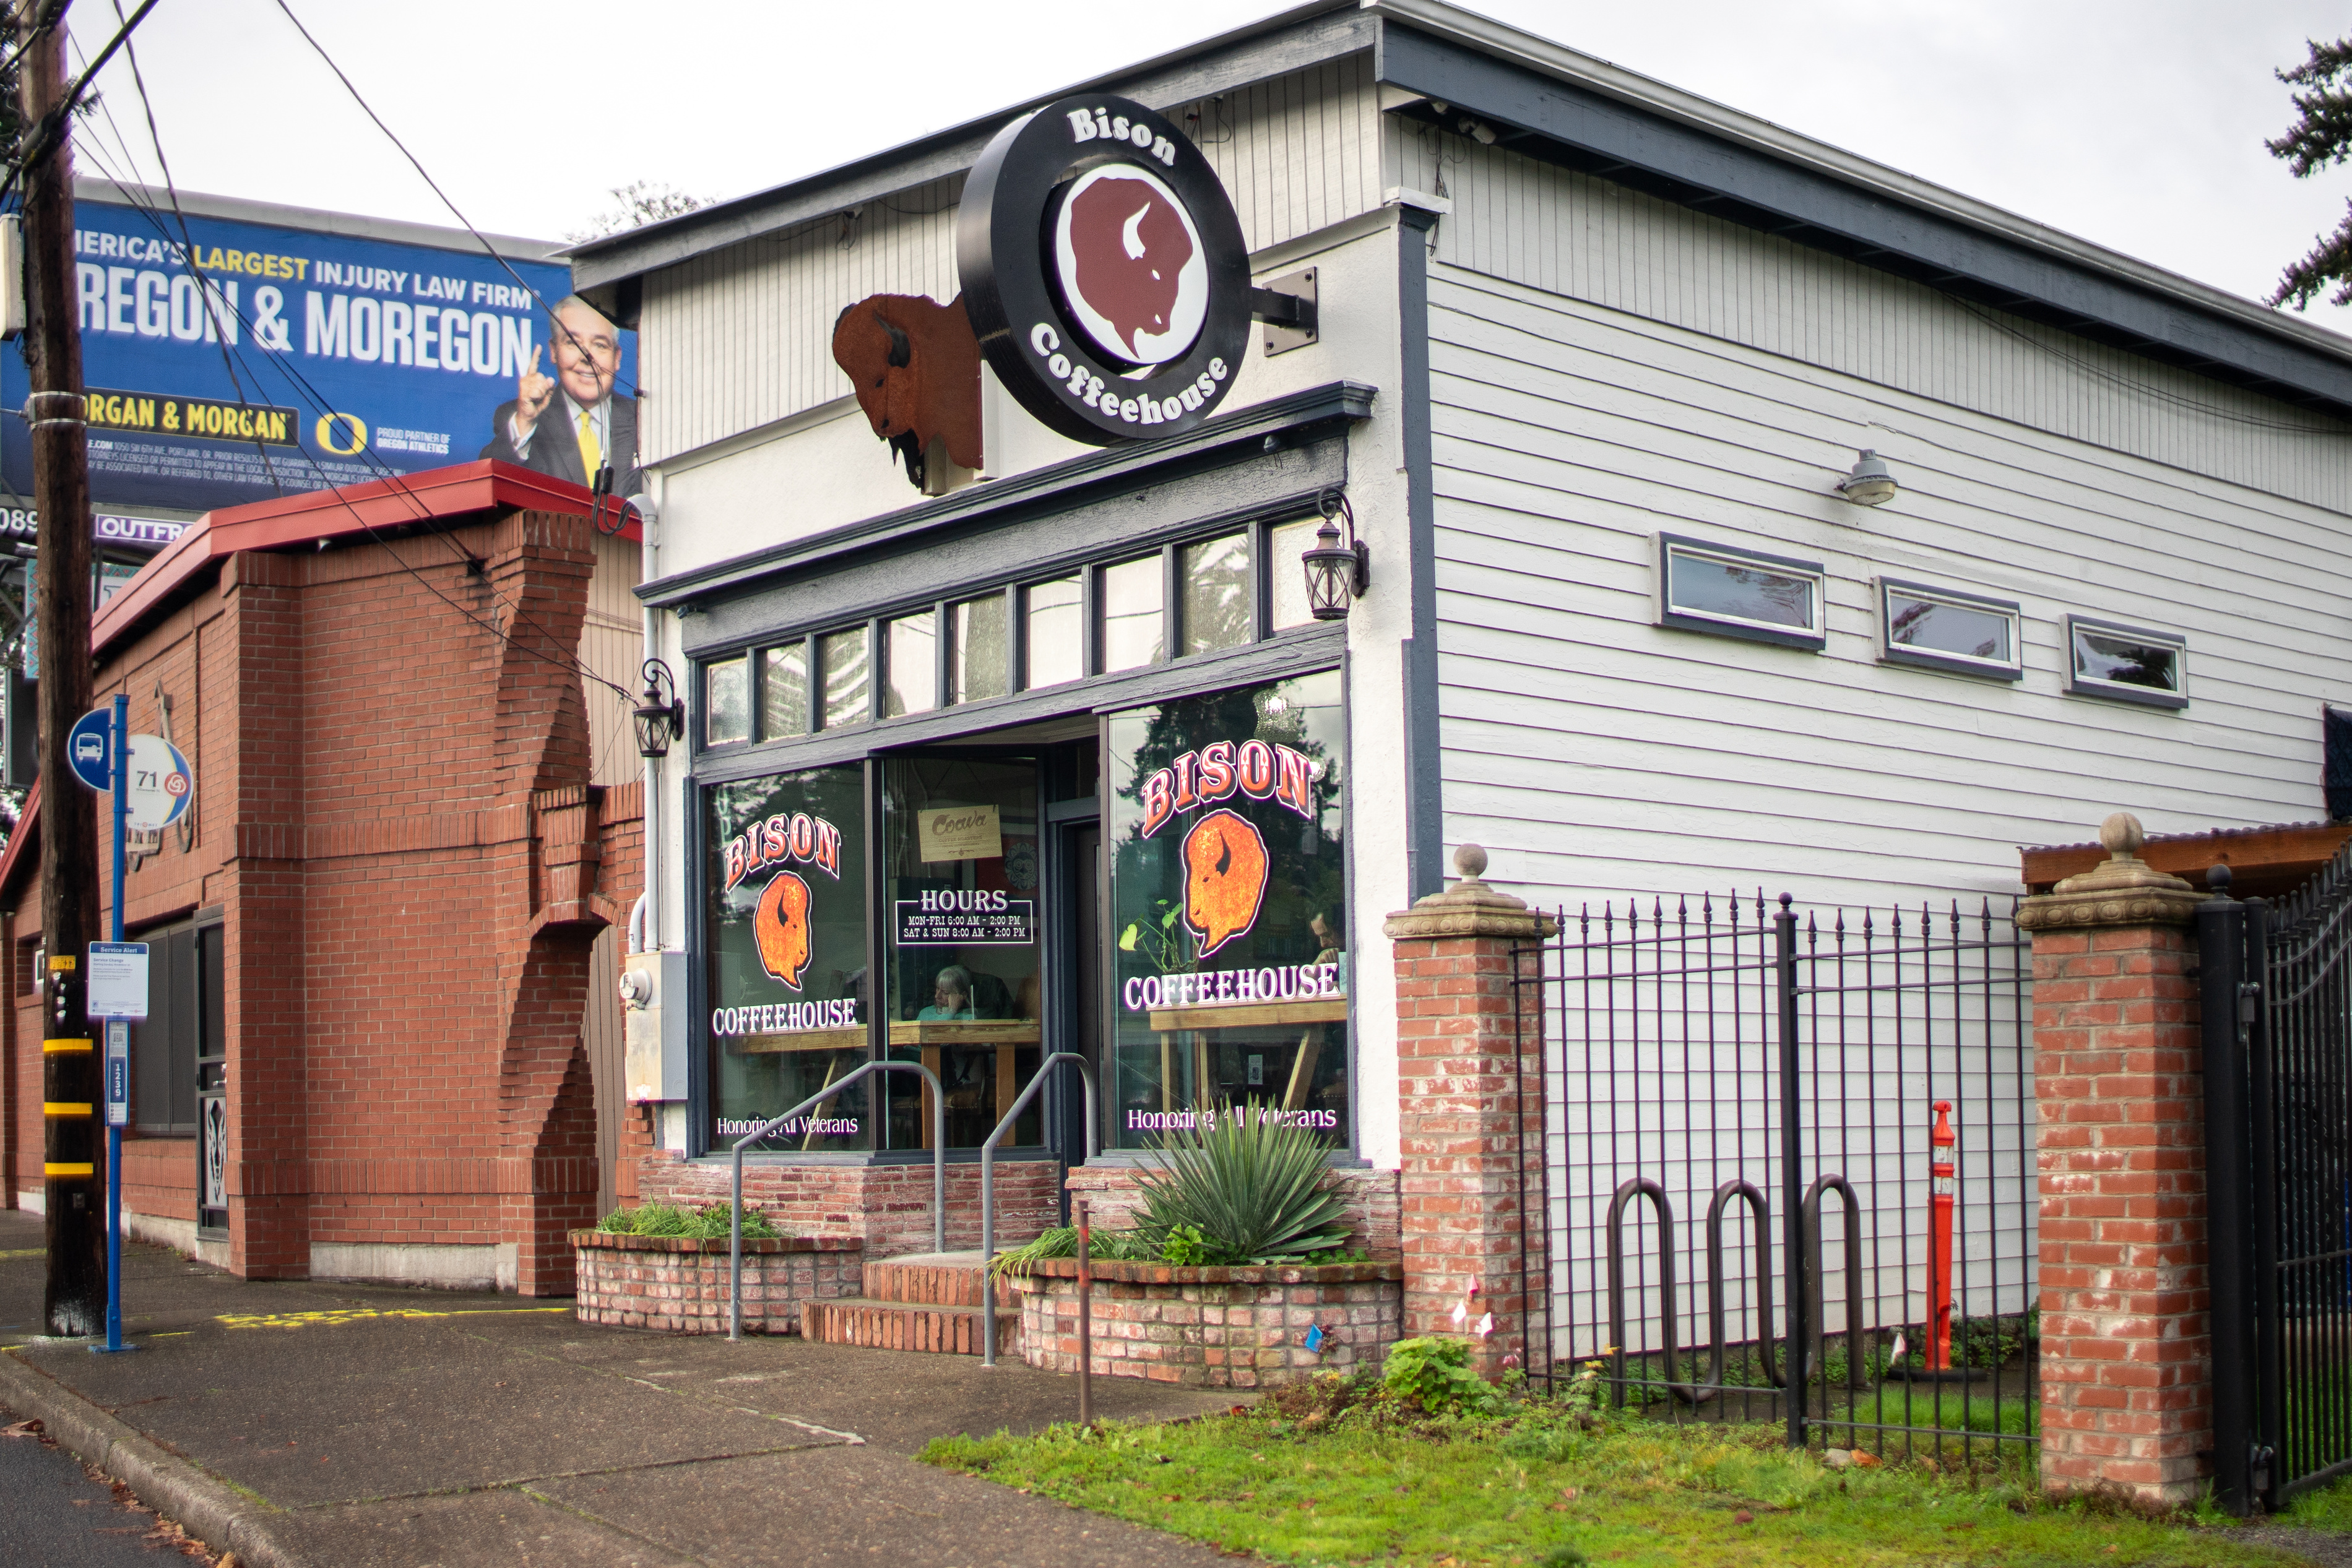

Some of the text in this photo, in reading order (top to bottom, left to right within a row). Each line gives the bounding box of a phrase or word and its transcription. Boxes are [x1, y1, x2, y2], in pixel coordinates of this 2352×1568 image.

[1066, 107, 1176, 166] Bison
[75, 229, 186, 265] ERICA'S
[194, 245, 309, 280] LARGEST
[316, 261, 409, 293] INJURY
[414, 274, 467, 301] LAW
[76, 261, 532, 377] REGON & MOREGON
[1031, 322, 1227, 424] Coffeehouse
[162, 401, 181, 429] &
[188, 403, 287, 440] MORGAN
[377, 427, 451, 444] PROUD PARTNER OF
[87, 439, 113, 449] E.COM
[377, 437, 449, 454] OREGON ATHLETICS
[137, 770, 157, 787] 71
[1142, 739, 1314, 839] BISON
[932, 810, 987, 835] Coava
[725, 812, 841, 894] BISON
[921, 890, 1008, 912] HOURS
[904, 928, 920, 937] SAT
[923, 928, 929, 937] &
[932, 928, 949, 937] SUN
[952, 928, 969, 937] 8:00
[972, 928, 985, 937] AM
[995, 928, 1011, 937] 2:00
[1013, 928, 1026, 937] PM
[908, 916, 945, 925] MON-FRI
[948, 916, 964, 925] 6:00
[967, 916, 980, 925] AM
[990, 916, 1006, 924] 2:00
[1008, 916, 1021, 924] PM
[1125, 962, 1340, 1010] COFFEEHOUSE
[713, 998, 858, 1035] COFFEEHOUSE
[799, 1116, 858, 1133] Veterans
